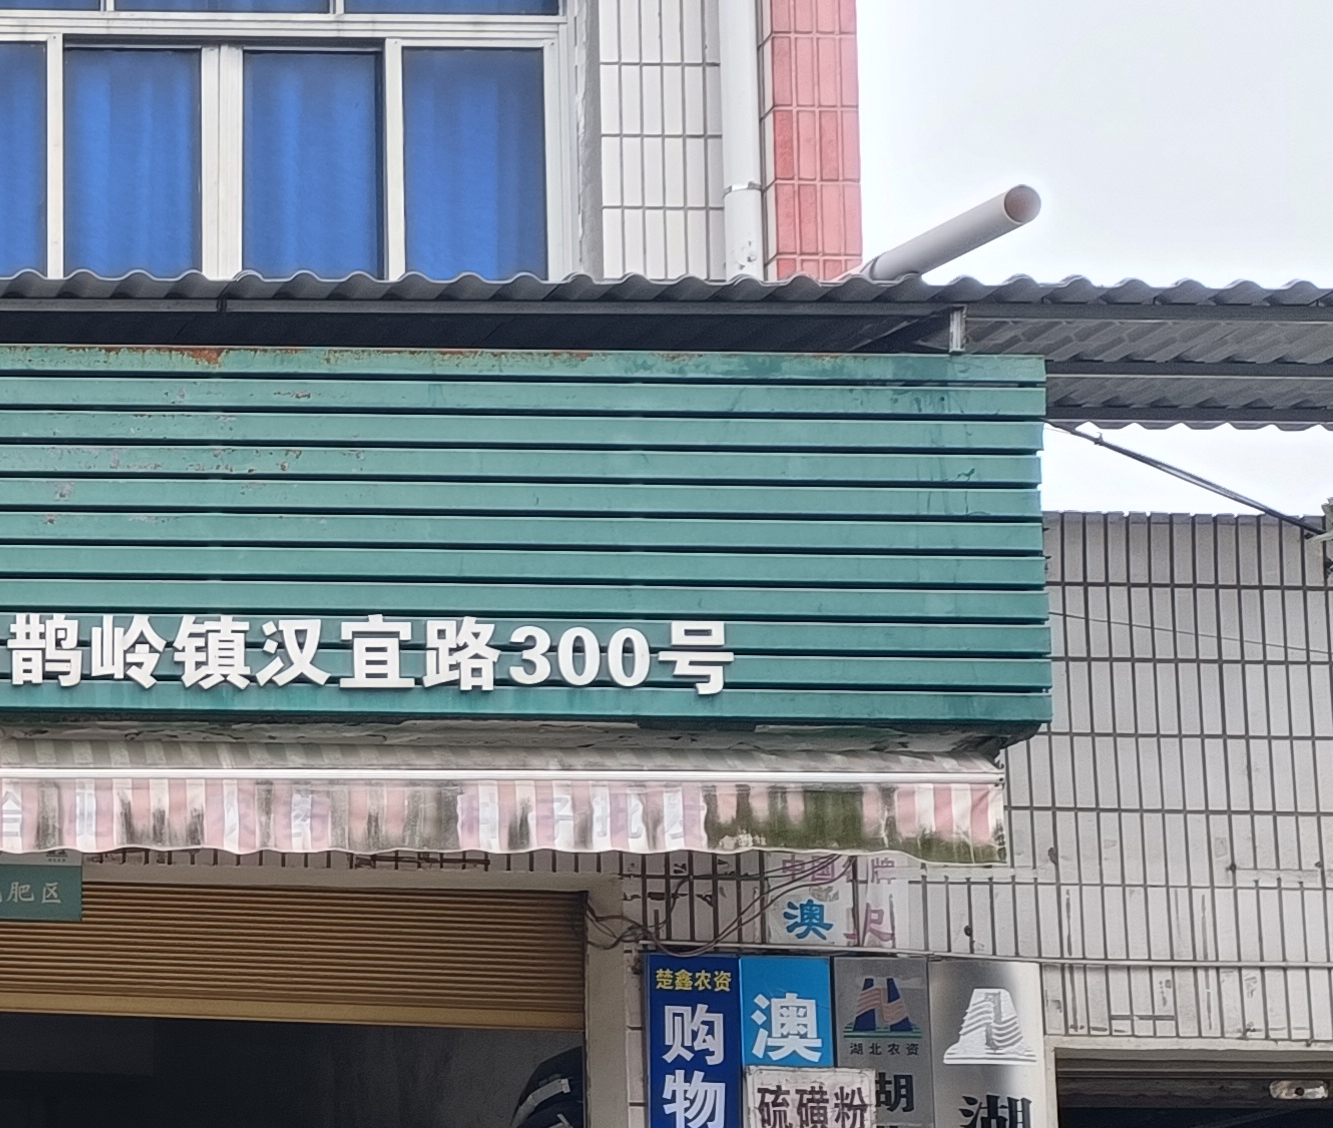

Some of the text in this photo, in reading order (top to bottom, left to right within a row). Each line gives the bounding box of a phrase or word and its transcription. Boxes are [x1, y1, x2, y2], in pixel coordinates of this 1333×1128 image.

[655, 968, 732, 992] 楚鑫农资
[750, 992, 823, 1063] 澳
[849, 1042, 921, 1056] 湖北农资
